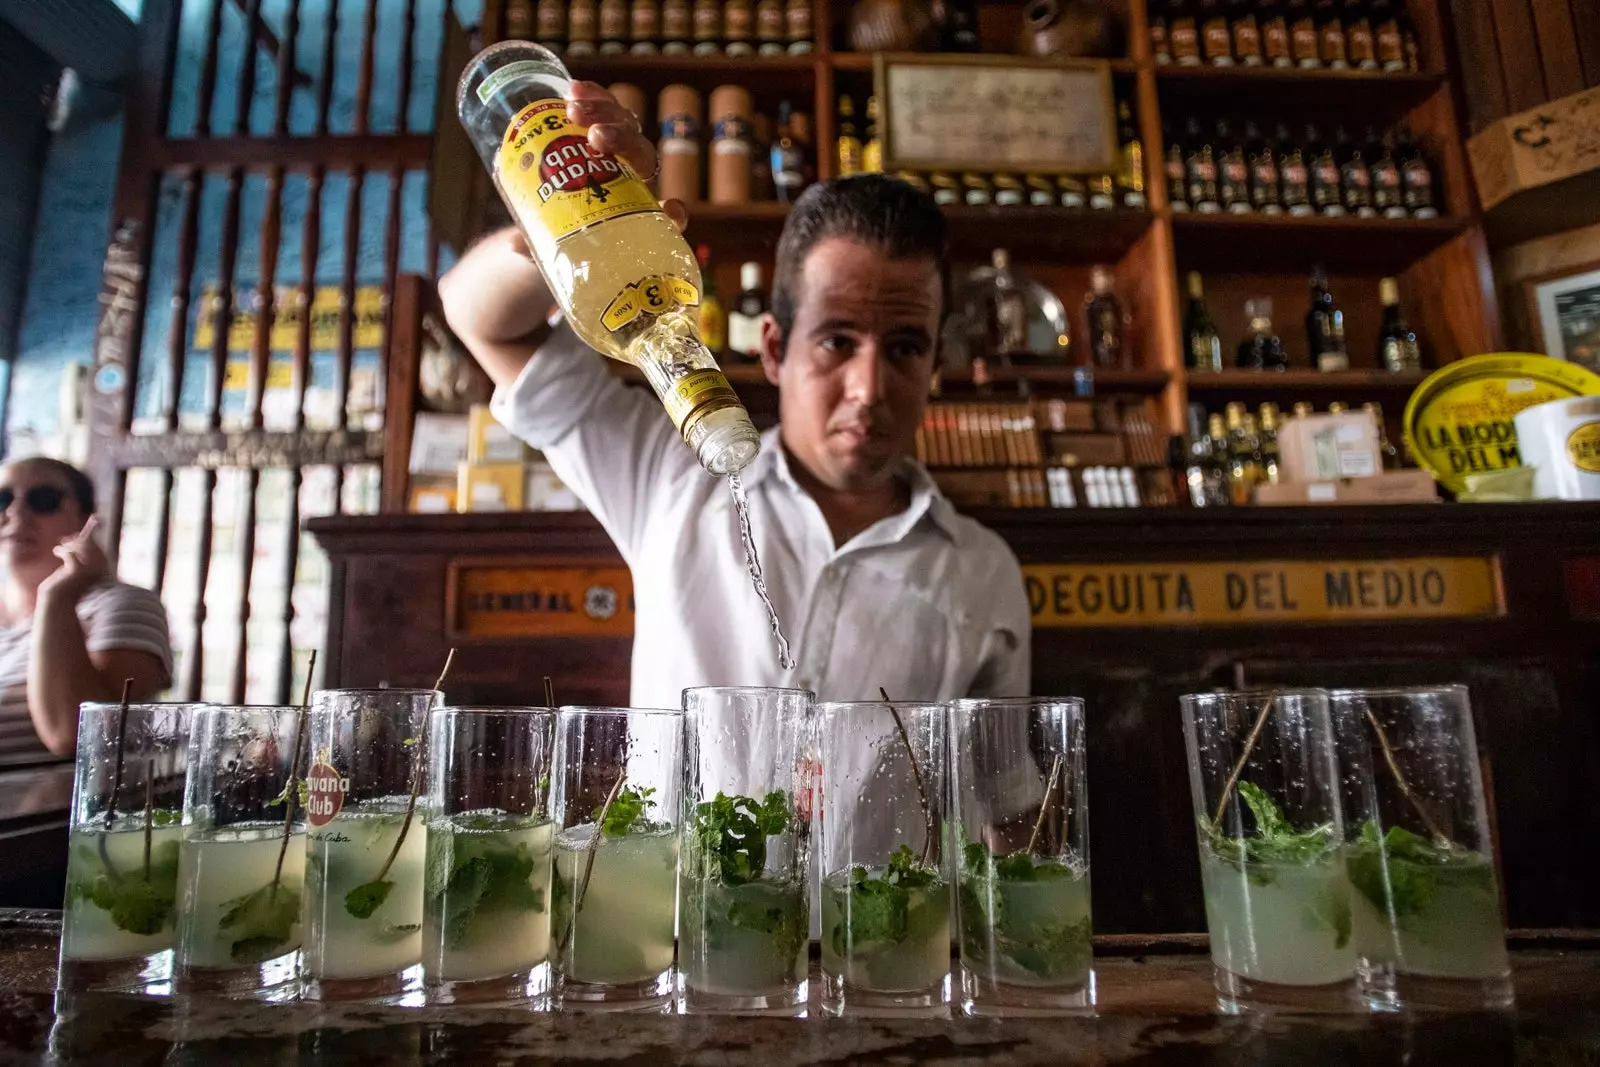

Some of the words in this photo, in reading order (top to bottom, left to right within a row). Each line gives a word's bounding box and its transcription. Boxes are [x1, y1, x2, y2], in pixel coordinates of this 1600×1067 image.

[543, 115, 564, 132] 3
[537, 158, 637, 204] Havana
[645, 284, 664, 307] 3
[1424, 425, 1452, 451] LA
[1457, 419, 1516, 447] BOD
[1448, 446, 1494, 474] DEL
[1024, 571, 1197, 617] DEGUITA
[1224, 569, 1300, 613] DEL
[1323, 566, 1447, 609] MEDIO
[308, 794, 334, 816] Club
[324, 831, 352, 843] Cuba
